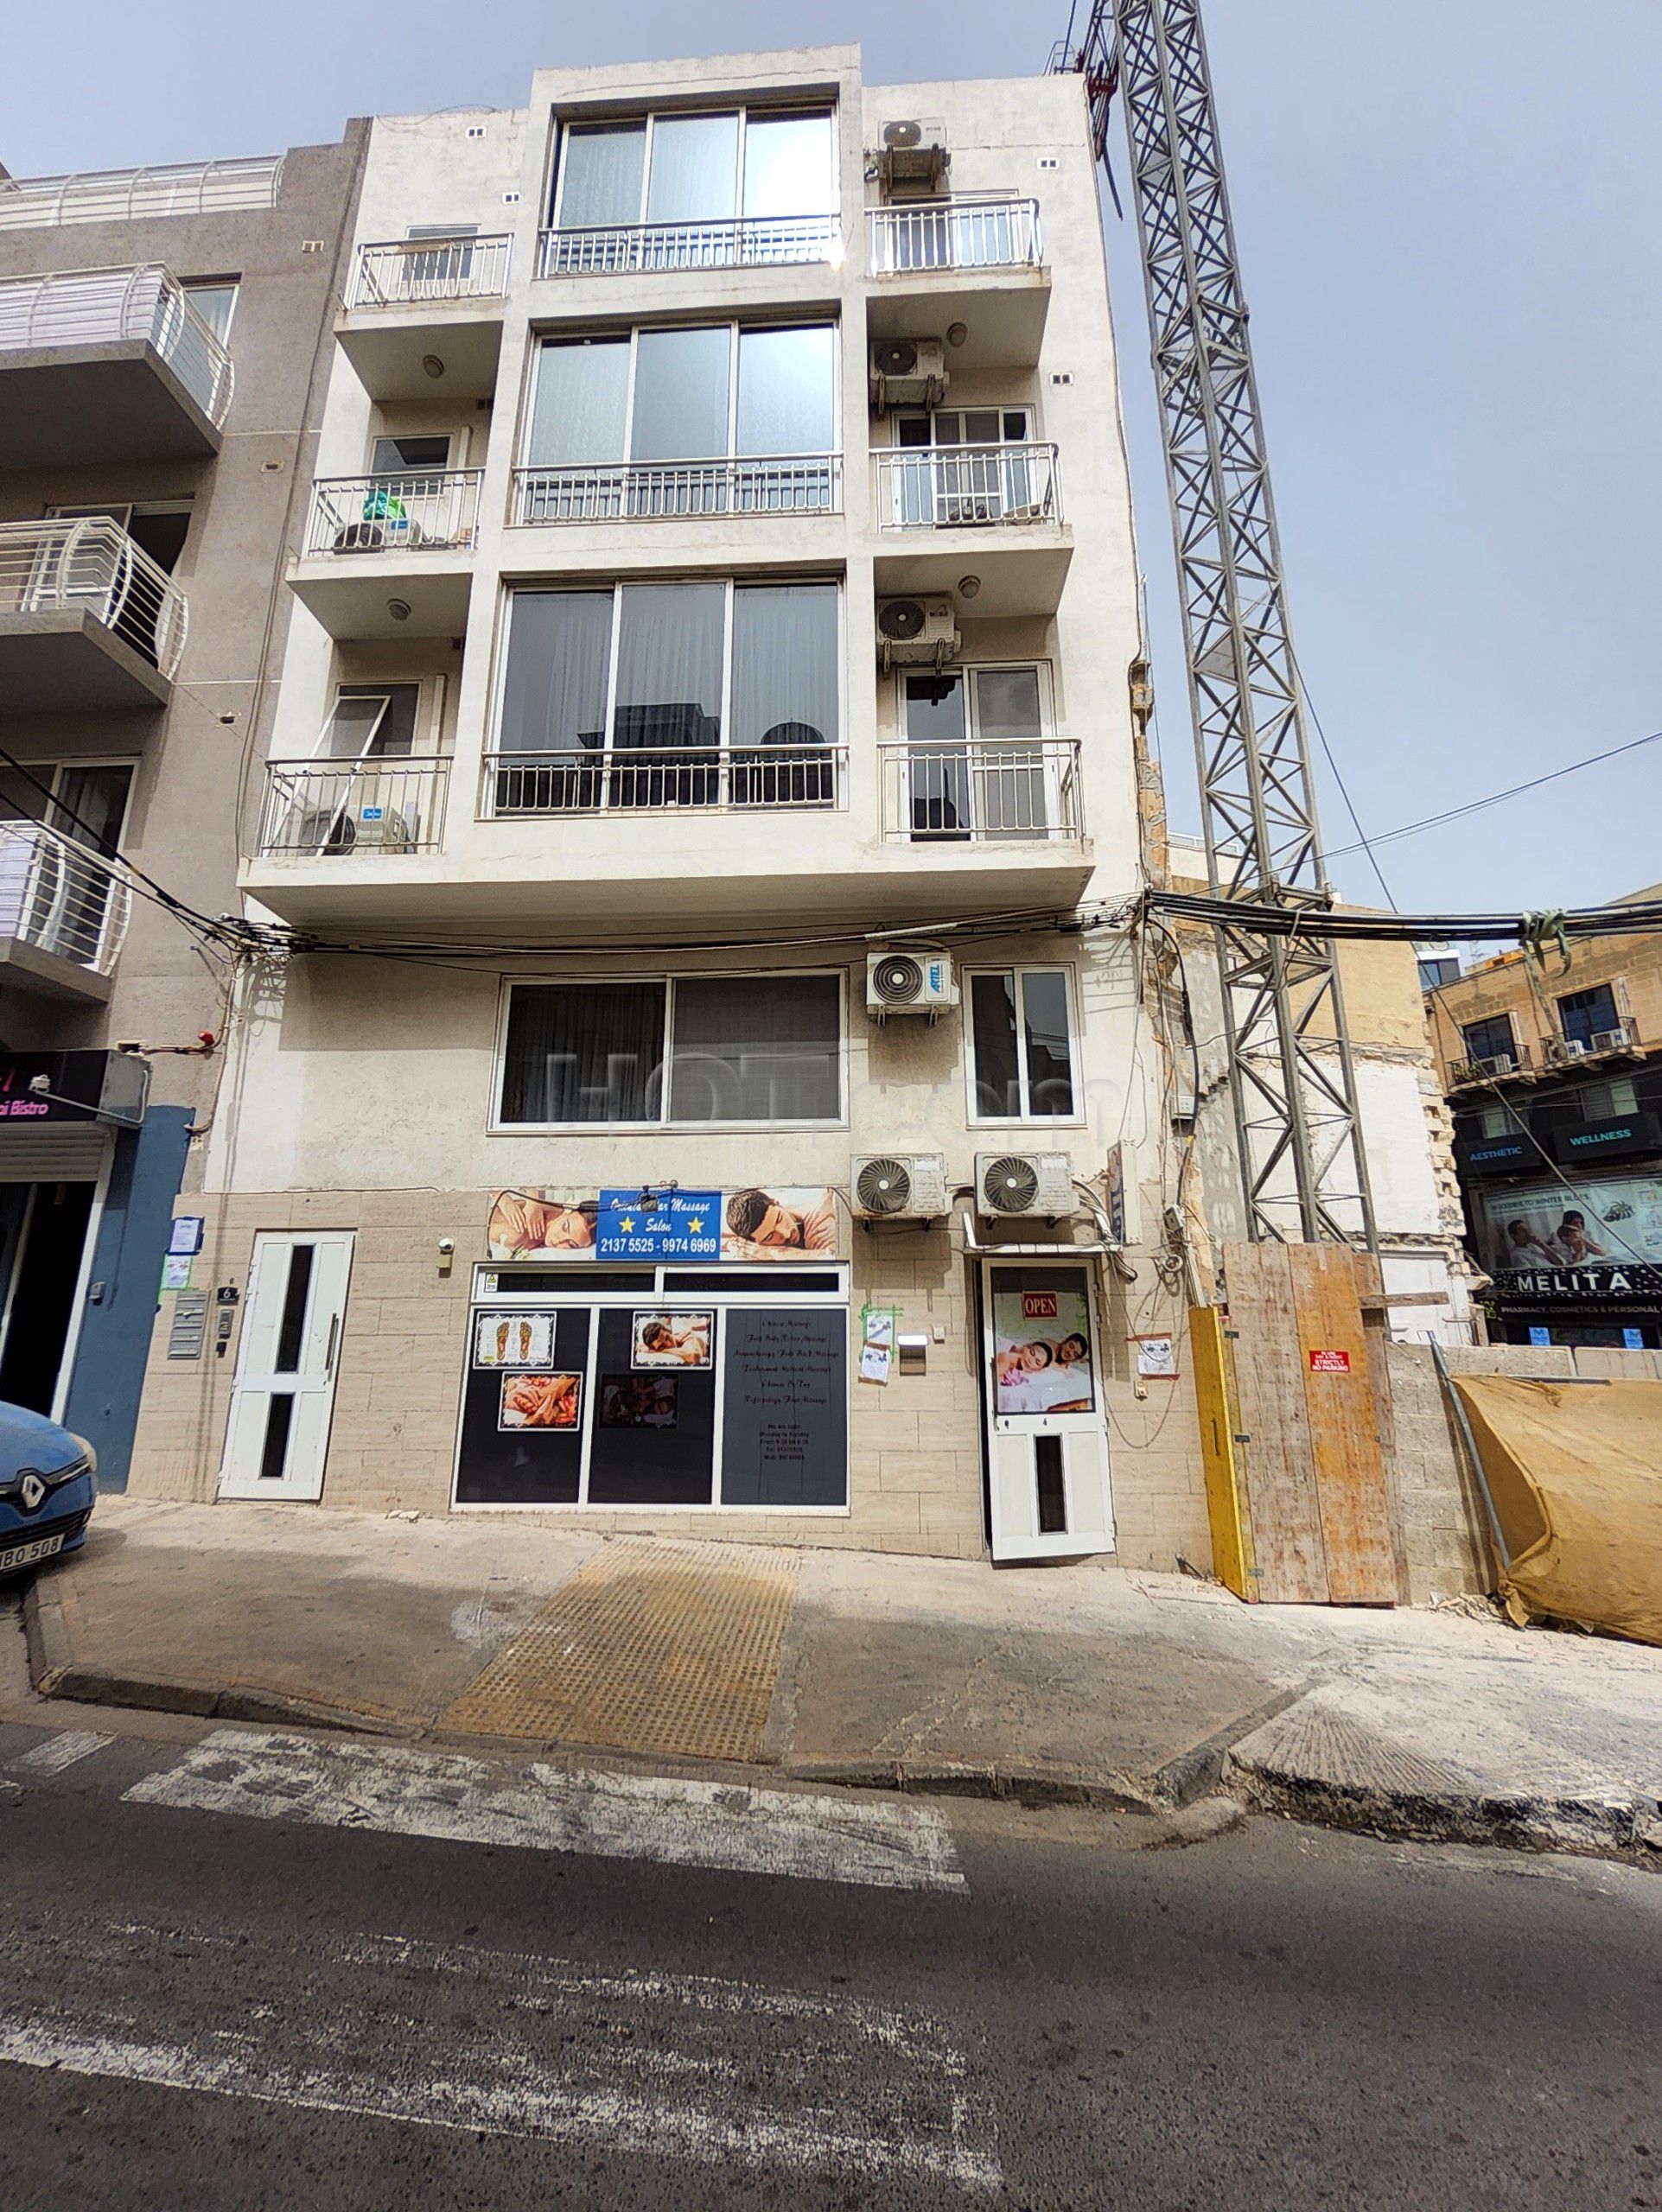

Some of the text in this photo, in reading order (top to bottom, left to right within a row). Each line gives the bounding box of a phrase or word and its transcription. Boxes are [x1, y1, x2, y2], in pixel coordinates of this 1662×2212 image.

[10, 1100, 49, 1116] Bistro
[1570, 1128, 1632, 1146] WELLNESS
[1470, 1146, 1523, 1161] AESTHETIC
[671, 1198, 710, 1214] Massage
[1535, 1195, 1563, 1205] WINTER
[645, 1217, 672, 1232] Salon
[601, 1237, 626, 1253] 2137
[627, 1237, 654, 1253] 5525
[662, 1237, 689, 1253] 9974
[691, 1237, 716, 1253] 6969
[1517, 1272, 1633, 1293] MELITA
[223, 1287, 231, 1299] 6
[1025, 1298, 1056, 1314] OPEN
[30, 1538, 60, 1558] 508
